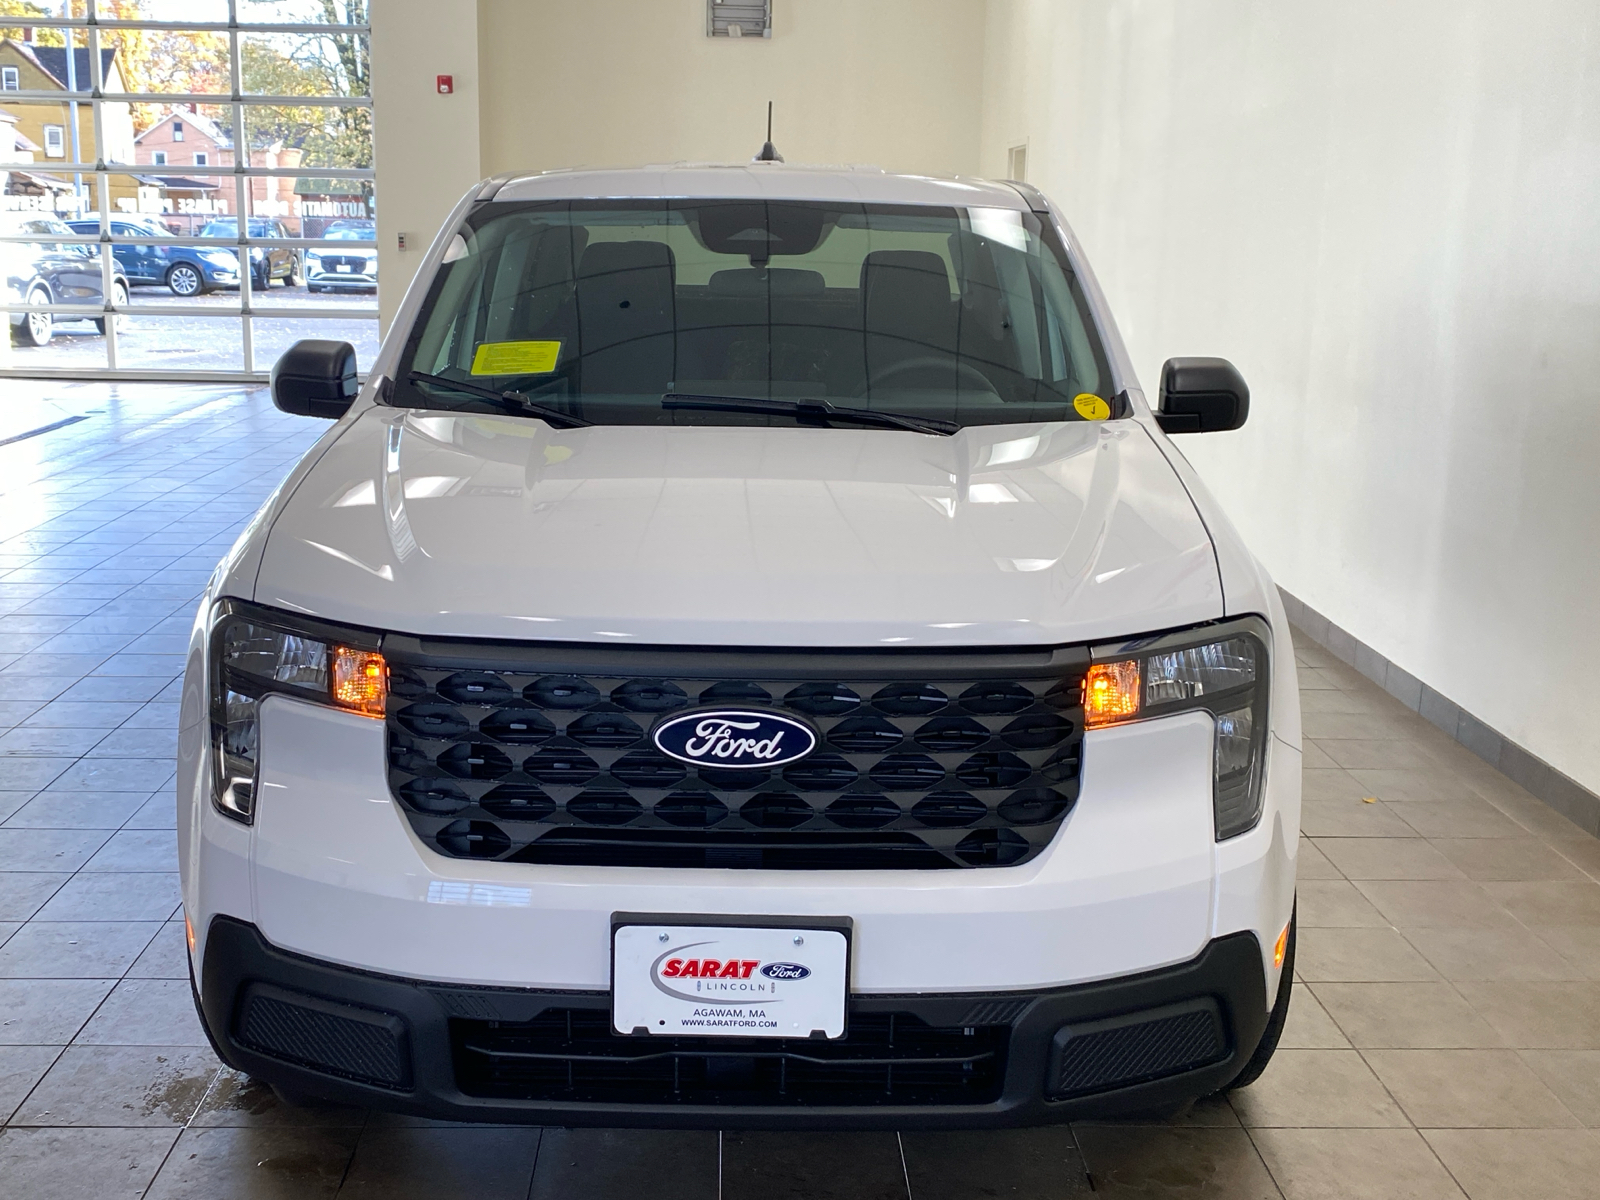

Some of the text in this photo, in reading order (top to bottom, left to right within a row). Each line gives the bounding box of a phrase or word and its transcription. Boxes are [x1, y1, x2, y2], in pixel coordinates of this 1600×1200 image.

[685, 719, 785, 759] Ford
[661, 958, 802, 980] SARAT Ford
[706, 982, 766, 992] LINCOLN
[693, 1008, 767, 1019] AGAWAM, MA
[681, 1019, 778, 1028] WWW.SARATFORD.COM
